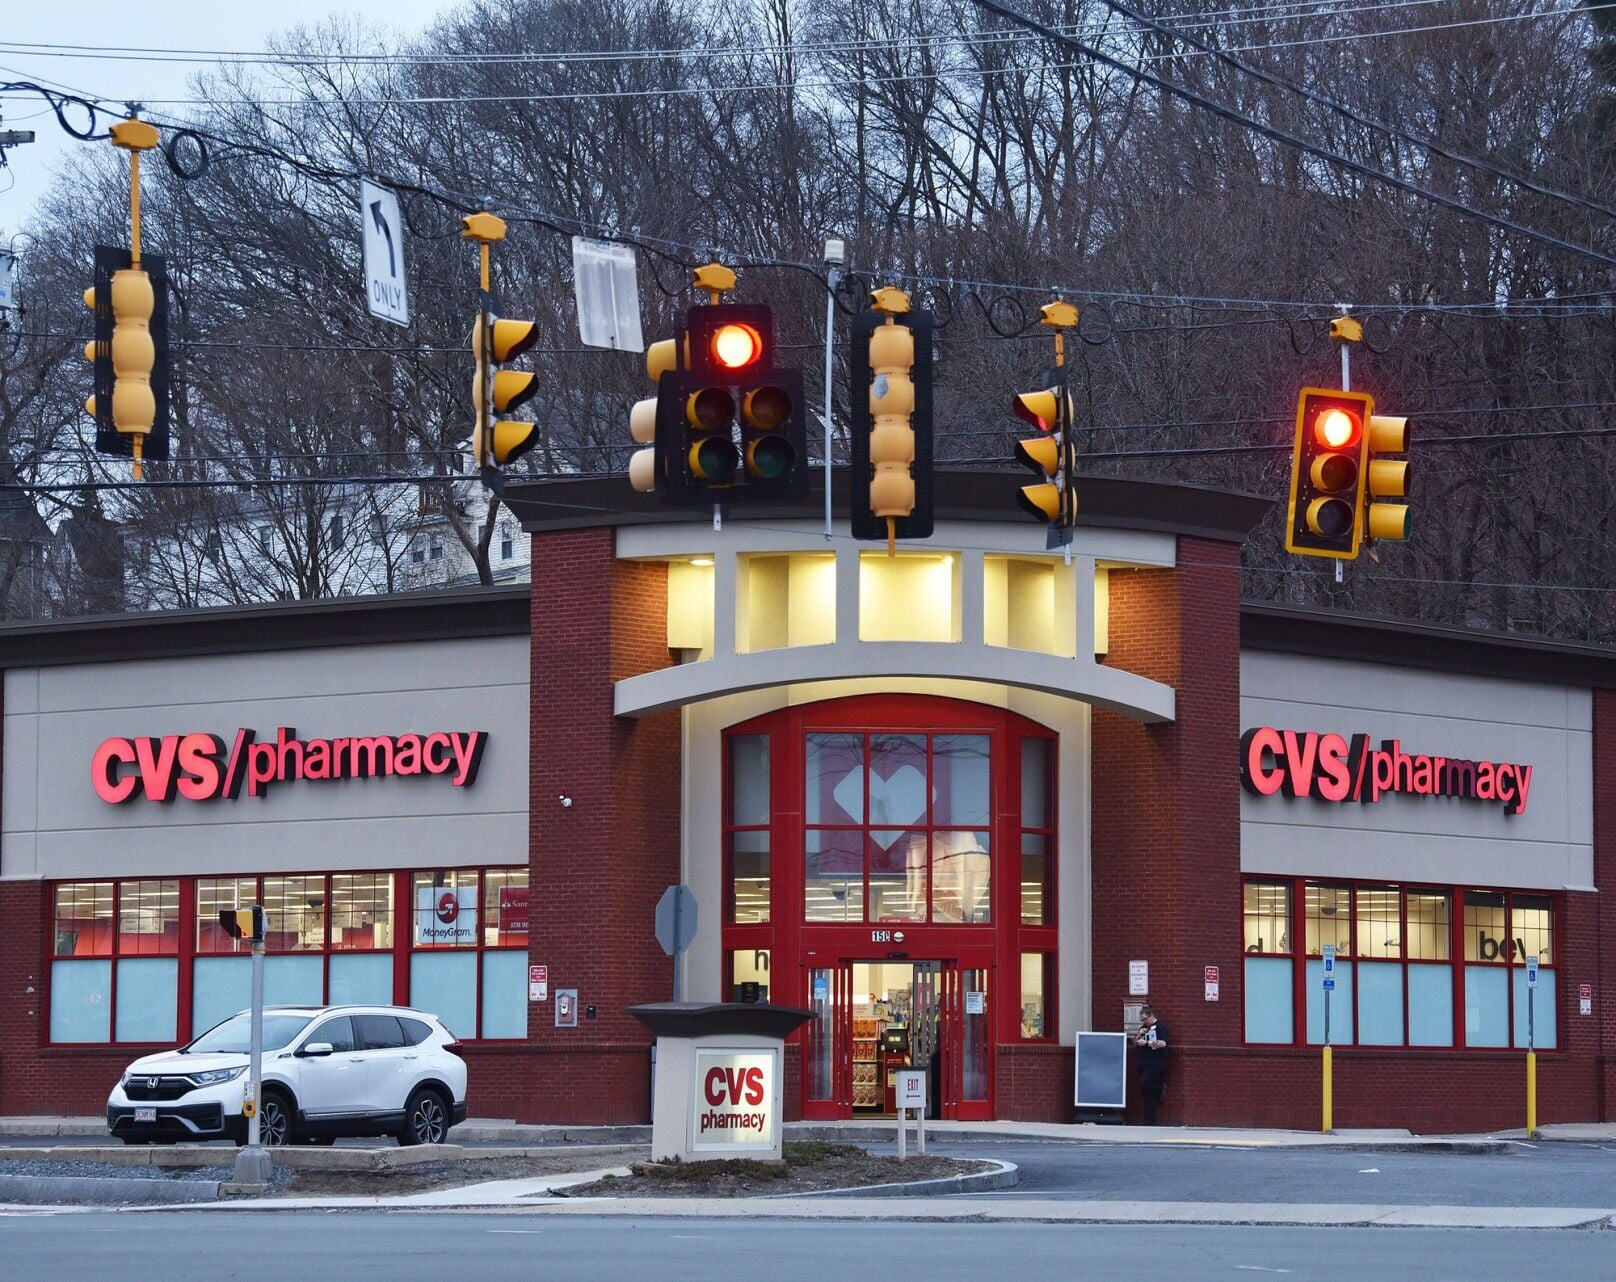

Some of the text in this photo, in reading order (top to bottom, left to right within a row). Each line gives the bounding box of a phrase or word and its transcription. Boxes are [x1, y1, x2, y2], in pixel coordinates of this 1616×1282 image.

[374, 280, 401, 311] ONLY
[91, 727, 487, 803] CVS/pharmacy
[1245, 727, 1533, 815] CVS/pharmacy
[704, 1066, 764, 1106] CVS
[907, 1078, 919, 1091] EXIT
[700, 1109, 766, 1133] pharmacy
